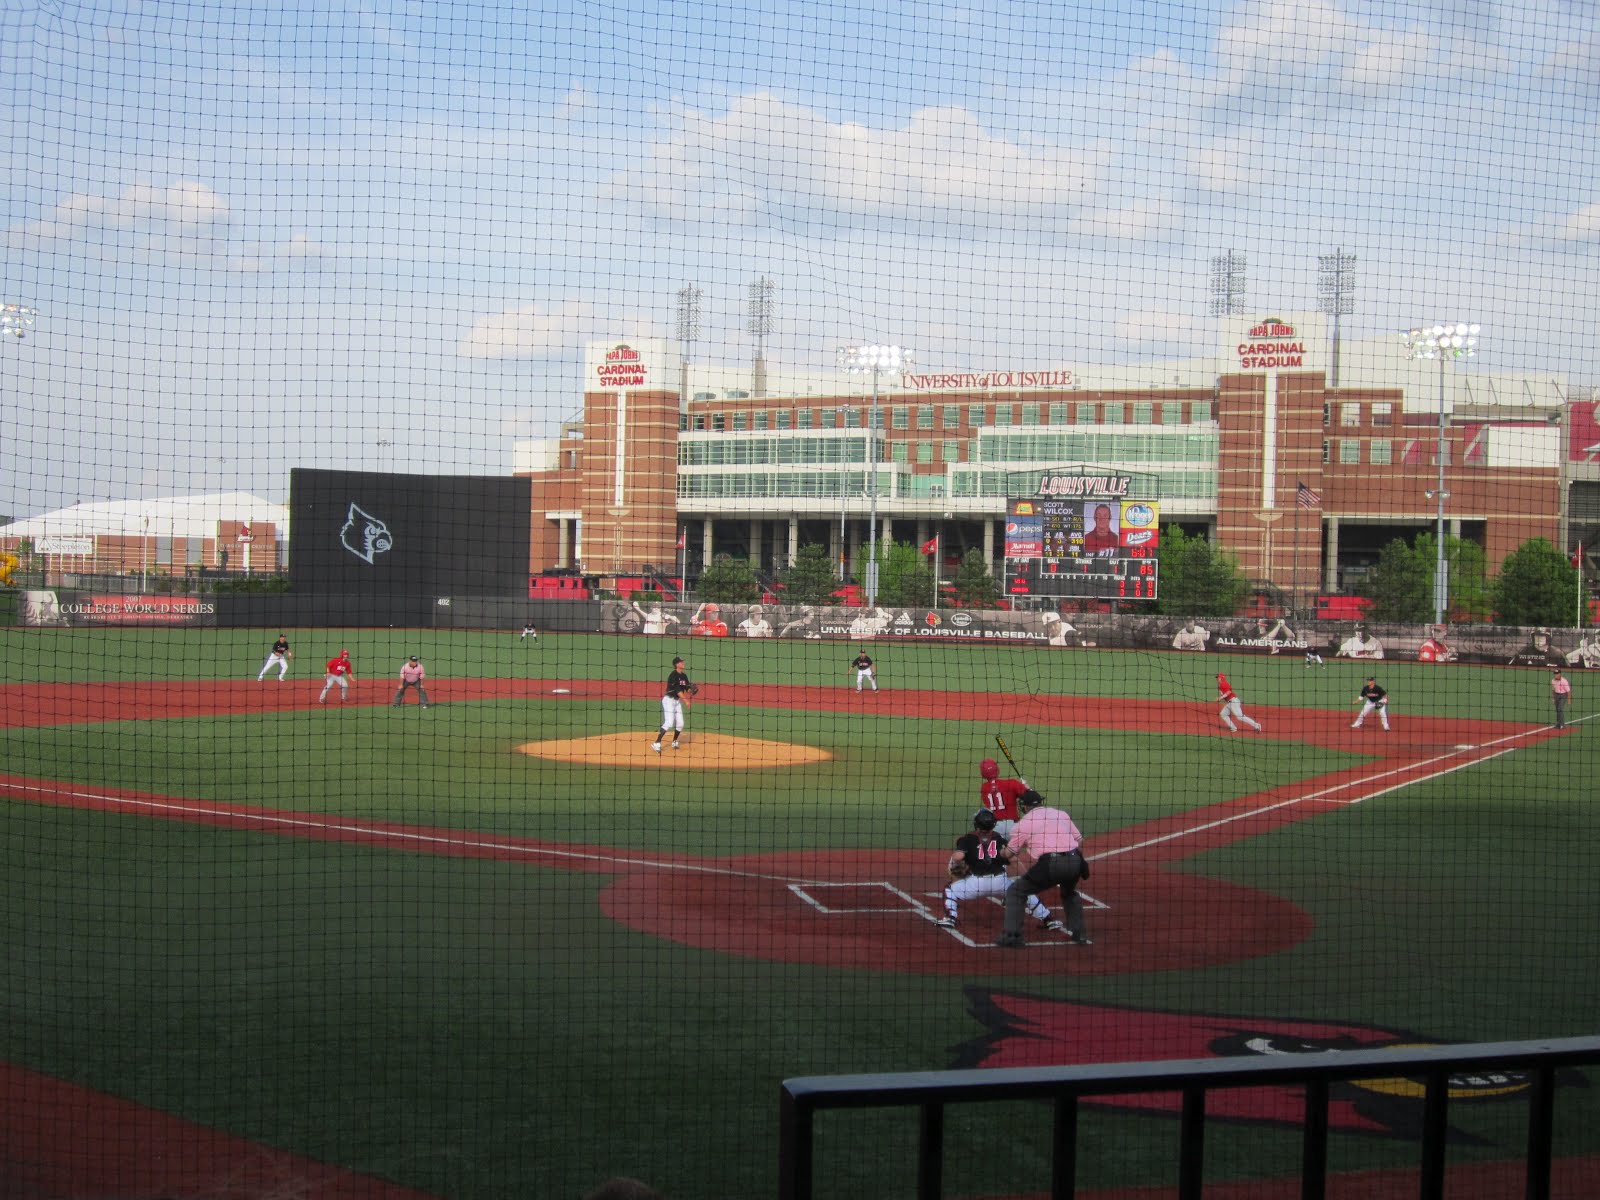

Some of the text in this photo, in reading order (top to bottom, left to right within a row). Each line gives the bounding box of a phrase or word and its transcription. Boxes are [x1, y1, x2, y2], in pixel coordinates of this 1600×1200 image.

[1238, 342, 1307, 355] CARDINAL
[1242, 355, 1302, 368] STADIUM
[597, 364, 647, 375] CARDINAL
[600, 376, 644, 386] STADIUM
[902, 371, 1072, 390] UNIVERSITY of LOUISVILLE
[1039, 476, 1130, 495] LOUISVILLE
[1019, 525, 1043, 534] pepsi
[52, 542, 90, 552] Steepleton
[1139, 564, 1153, 575] 85
[126, 595, 142, 603] 2007
[437, 598, 450, 606] 402
[60, 604, 214, 614] COLLEGE WORLD SERIES
[820, 626, 1048, 639] UNIVERSITY OF LOUISVILLE BASEBALL
[1216, 637, 1308, 648] ALL AMERICANS
[987, 792, 1006, 811] 11
[977, 841, 997, 859] 14
